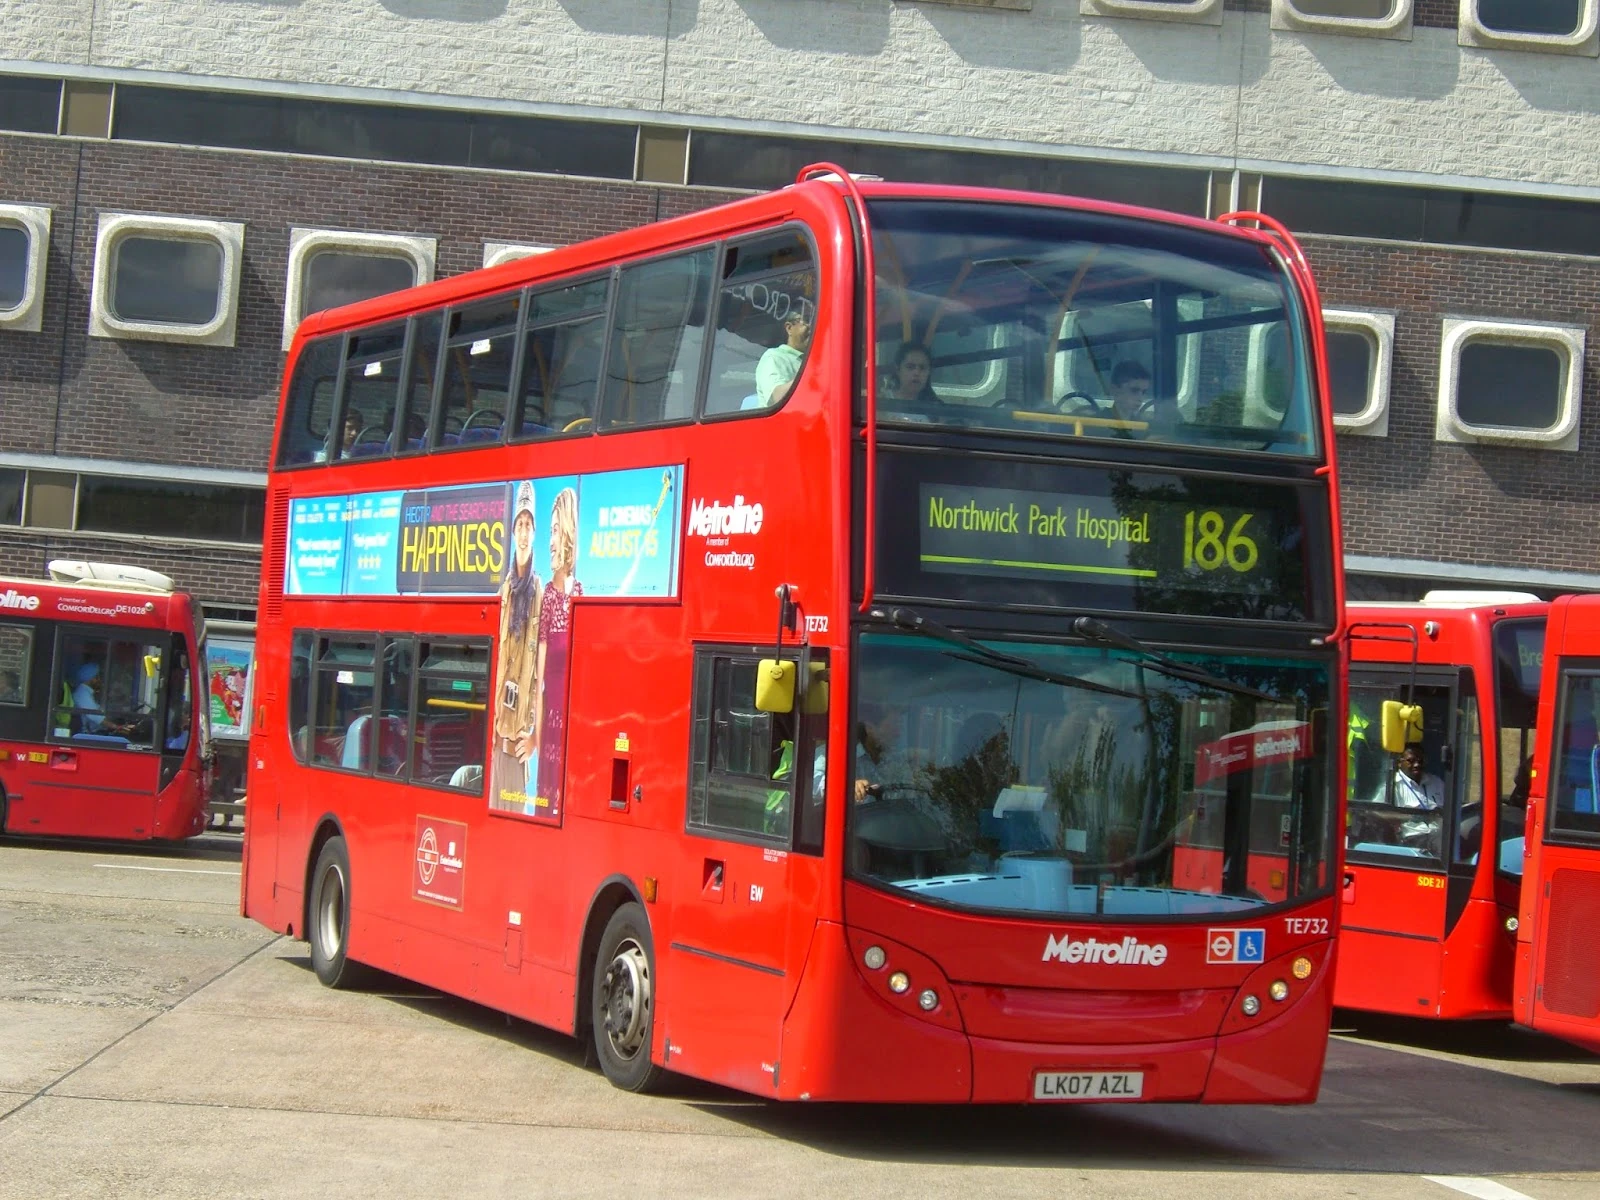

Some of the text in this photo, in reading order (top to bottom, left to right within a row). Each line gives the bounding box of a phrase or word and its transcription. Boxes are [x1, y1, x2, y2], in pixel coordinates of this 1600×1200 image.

[687, 495, 763, 536] Metroline
[929, 497, 1150, 548] Northwick Park Hospital
[402, 522, 504, 573] HAPPINESS
[1184, 510, 1258, 572] 186
[116, 605, 146, 615] DE1028
[805, 616, 828, 632] TE732
[16, 753, 26, 761] W
[1417, 876, 1445, 889] SDE 21
[750, 884, 764, 902] EW
[1285, 918, 1329, 934] TE732
[1042, 933, 1168, 967] Metroline
[1043, 1075, 1135, 1095] LK07 AZL
